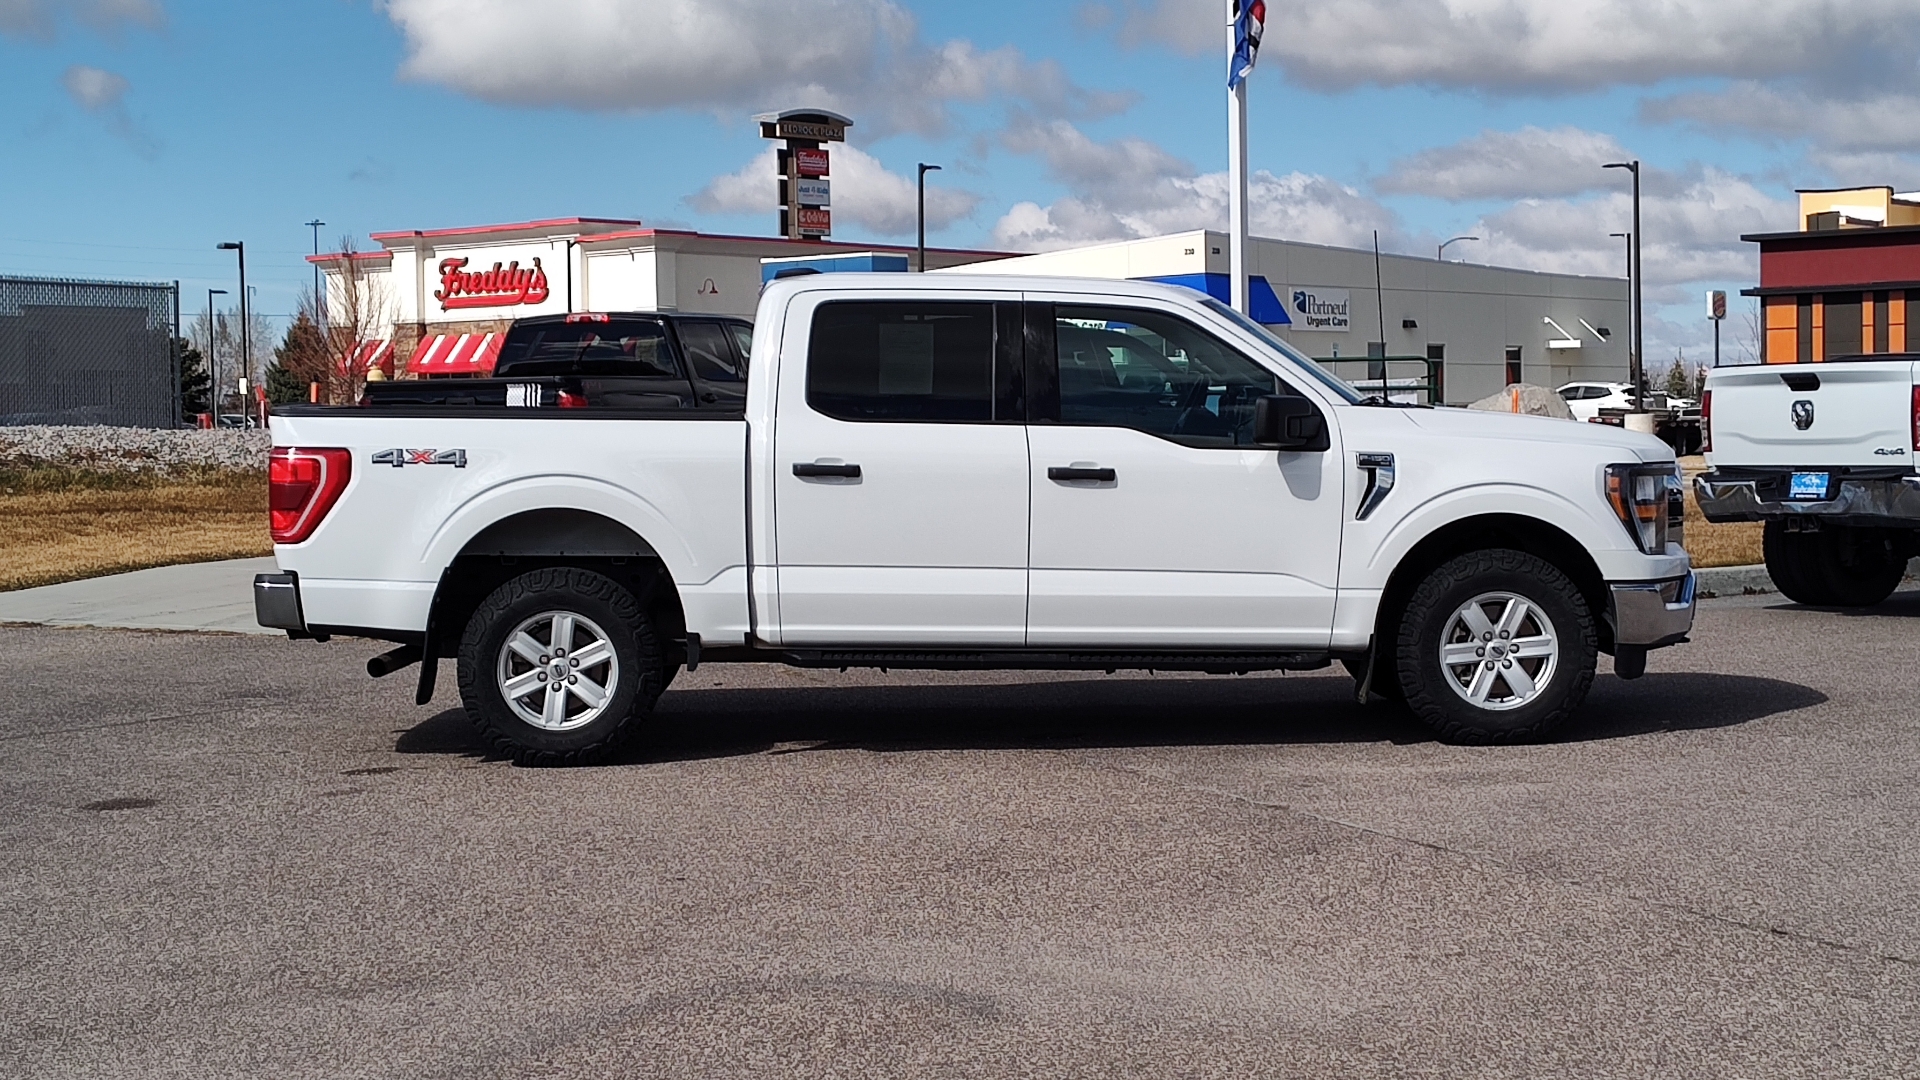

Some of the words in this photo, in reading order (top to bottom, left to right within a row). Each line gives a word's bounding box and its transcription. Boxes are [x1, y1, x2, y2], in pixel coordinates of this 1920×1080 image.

[783, 123, 817, 135] BEDROCK
[820, 126, 843, 137] PLAZA
[434, 257, 549, 312] Freddy's
[1307, 294, 1347, 315] Portneuf
[1306, 316, 1331, 327] Urgent
[1332, 316, 1348, 326] Care
